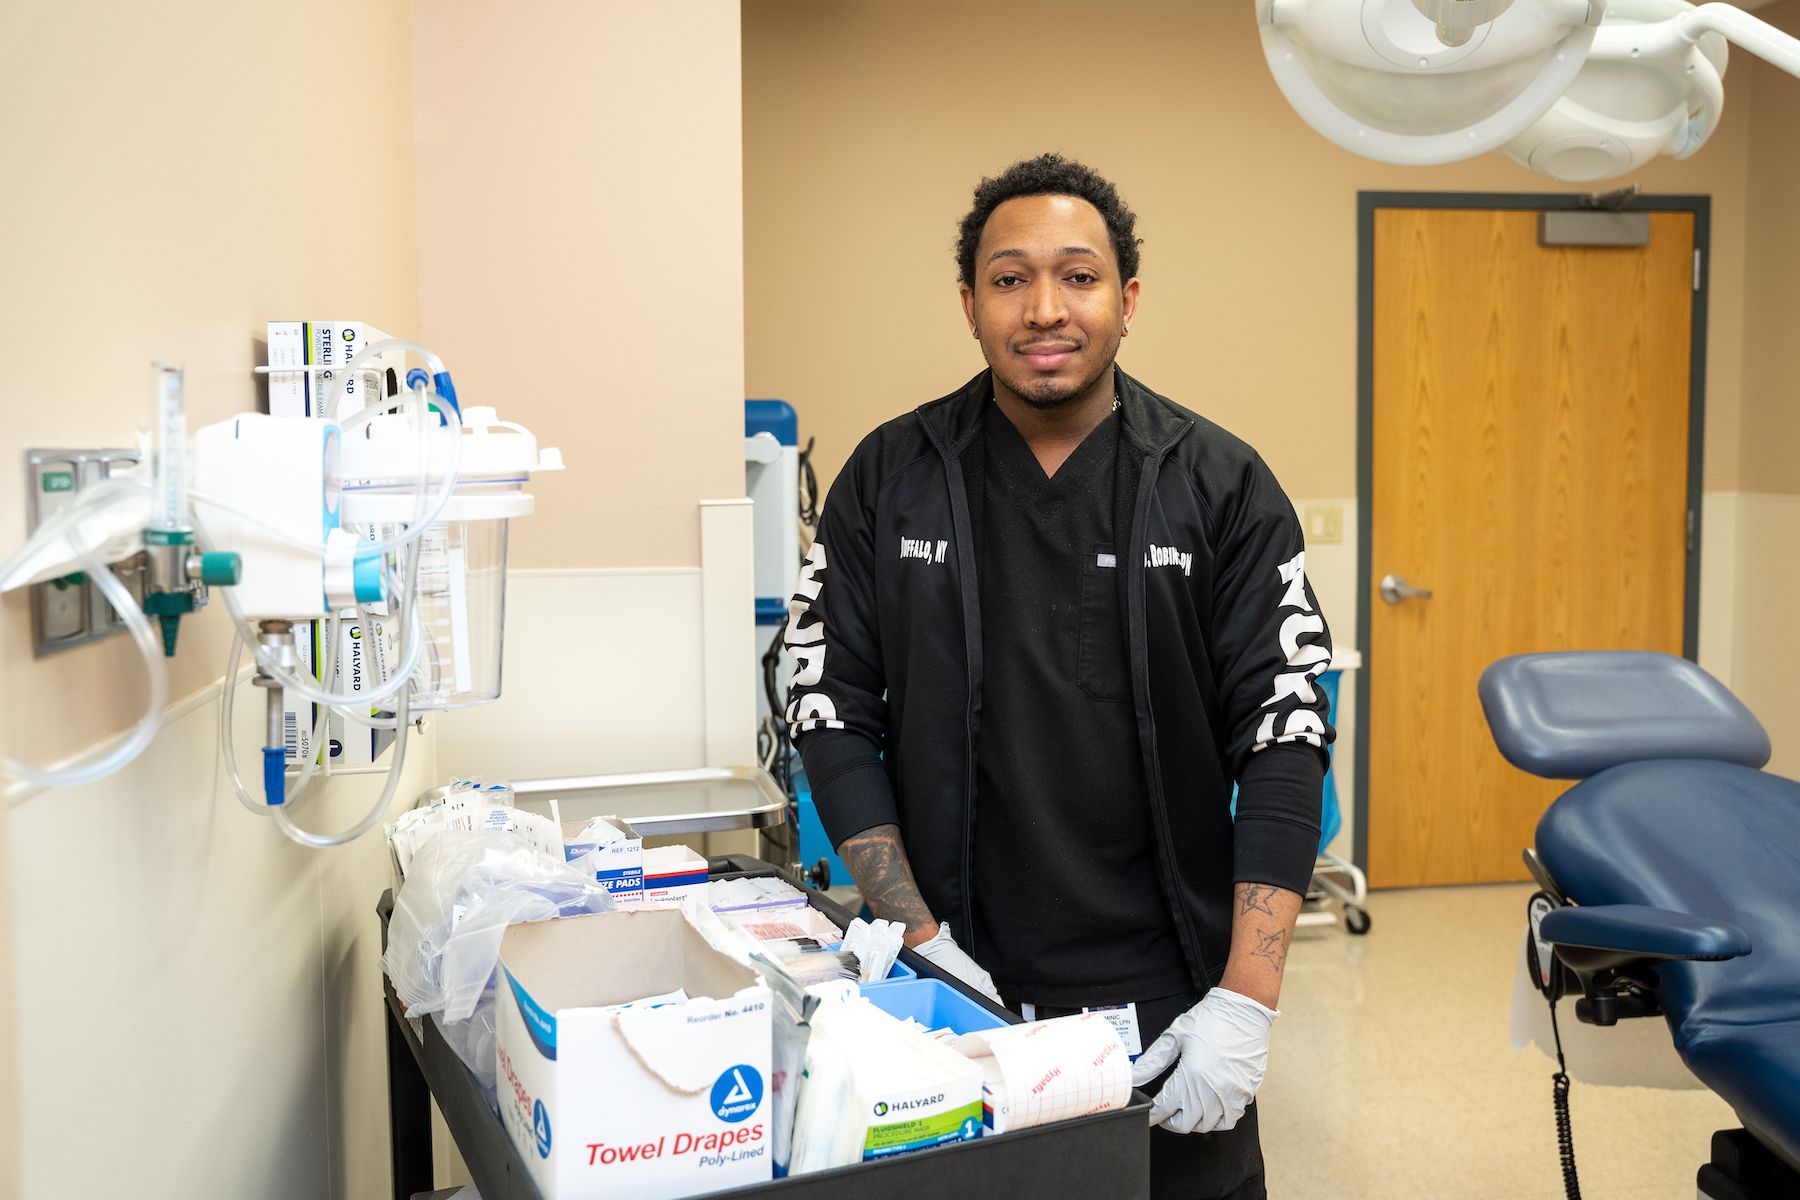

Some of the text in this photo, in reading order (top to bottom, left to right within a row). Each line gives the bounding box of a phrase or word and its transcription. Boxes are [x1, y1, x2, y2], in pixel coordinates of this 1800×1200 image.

[322, 328, 332, 378] STERLIG
[935, 539, 948, 563] NY
[352, 642, 361, 691] HALYARD
[615, 878, 641, 889] PADS
[687, 1002, 765, 1024] Reorder No. 4410
[1031, 1066, 1062, 1096] Hypafix
[717, 1101, 756, 1118] dynarex
[892, 1093, 945, 1111] HALYARD
[586, 1136, 665, 1166] Towel
[672, 1124, 764, 1156] Drapes
[699, 1145, 765, 1168] Poly-Lined
